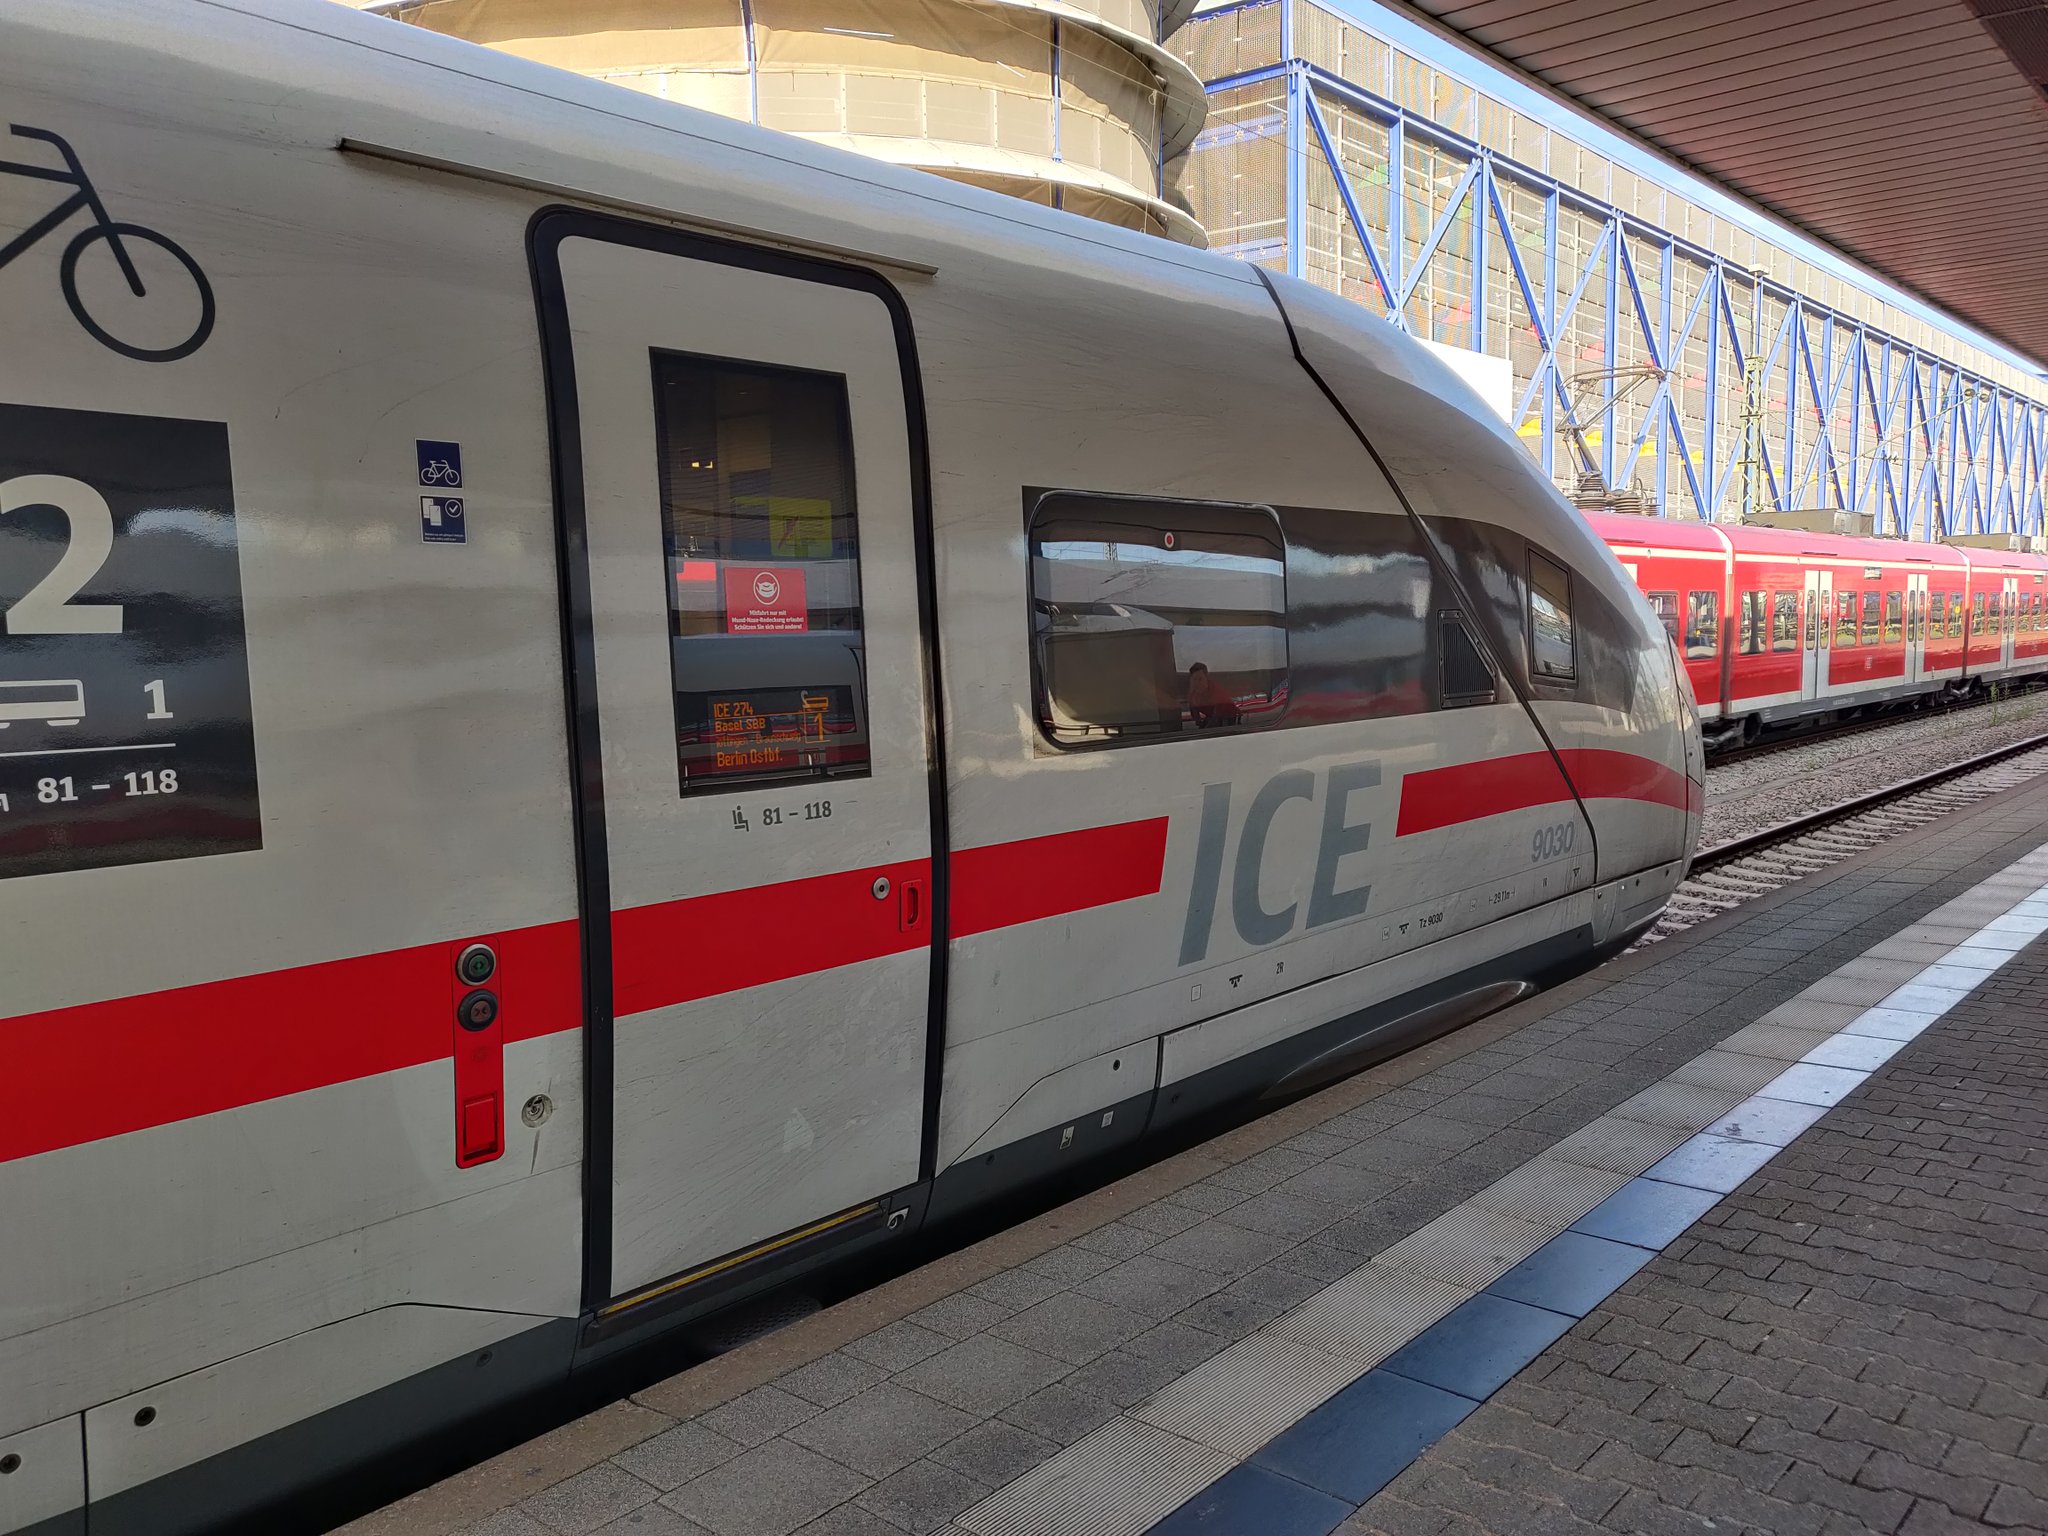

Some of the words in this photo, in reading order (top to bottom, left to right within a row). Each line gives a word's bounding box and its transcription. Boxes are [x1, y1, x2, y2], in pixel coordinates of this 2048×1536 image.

[0, 474, 123, 634] 2
[144, 680, 173, 719] 1
[713, 703, 731, 718] ICE
[733, 702, 753, 716] 274
[715, 721, 743, 732] Basel
[746, 718, 766, 730] SBB
[814, 713, 824, 740] 1
[717, 751, 748, 767] Berlin
[750, 747, 783, 764] Ostbf.
[38, 776, 78, 803] 81
[124, 769, 178, 796] 118
[763, 807, 783, 825] 81
[805, 801, 832, 820] 118
[1531, 821, 1574, 862] 9030
[1178, 759, 1382, 967] ICE
[1419, 918, 1427, 928] Tz
[1428, 912, 1443, 926] 9030
